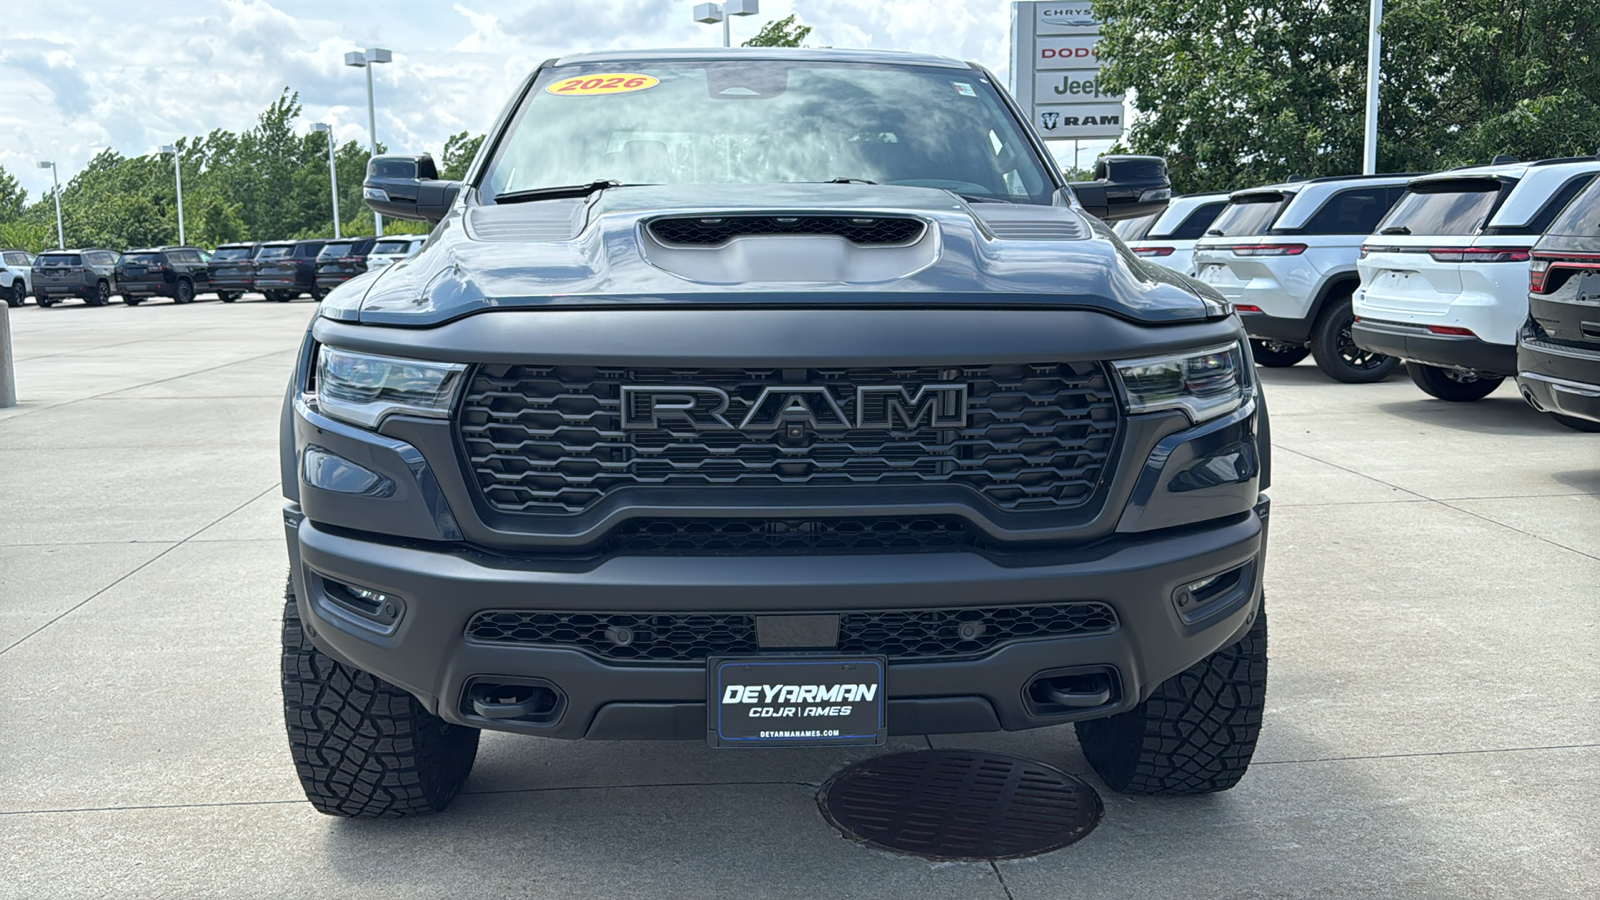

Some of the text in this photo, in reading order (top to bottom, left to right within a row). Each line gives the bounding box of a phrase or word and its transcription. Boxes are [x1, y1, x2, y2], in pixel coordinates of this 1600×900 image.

[1041, 48, 1096, 58] DOD
[556, 77, 648, 92] 2026
[1064, 116, 1119, 126] RAM
[620, 384, 967, 429] RAM
[722, 684, 877, 704] DEYARMAN
[749, 706, 852, 717] CDJR AMES
[760, 730, 839, 738] DEYARMANAMES.COM
